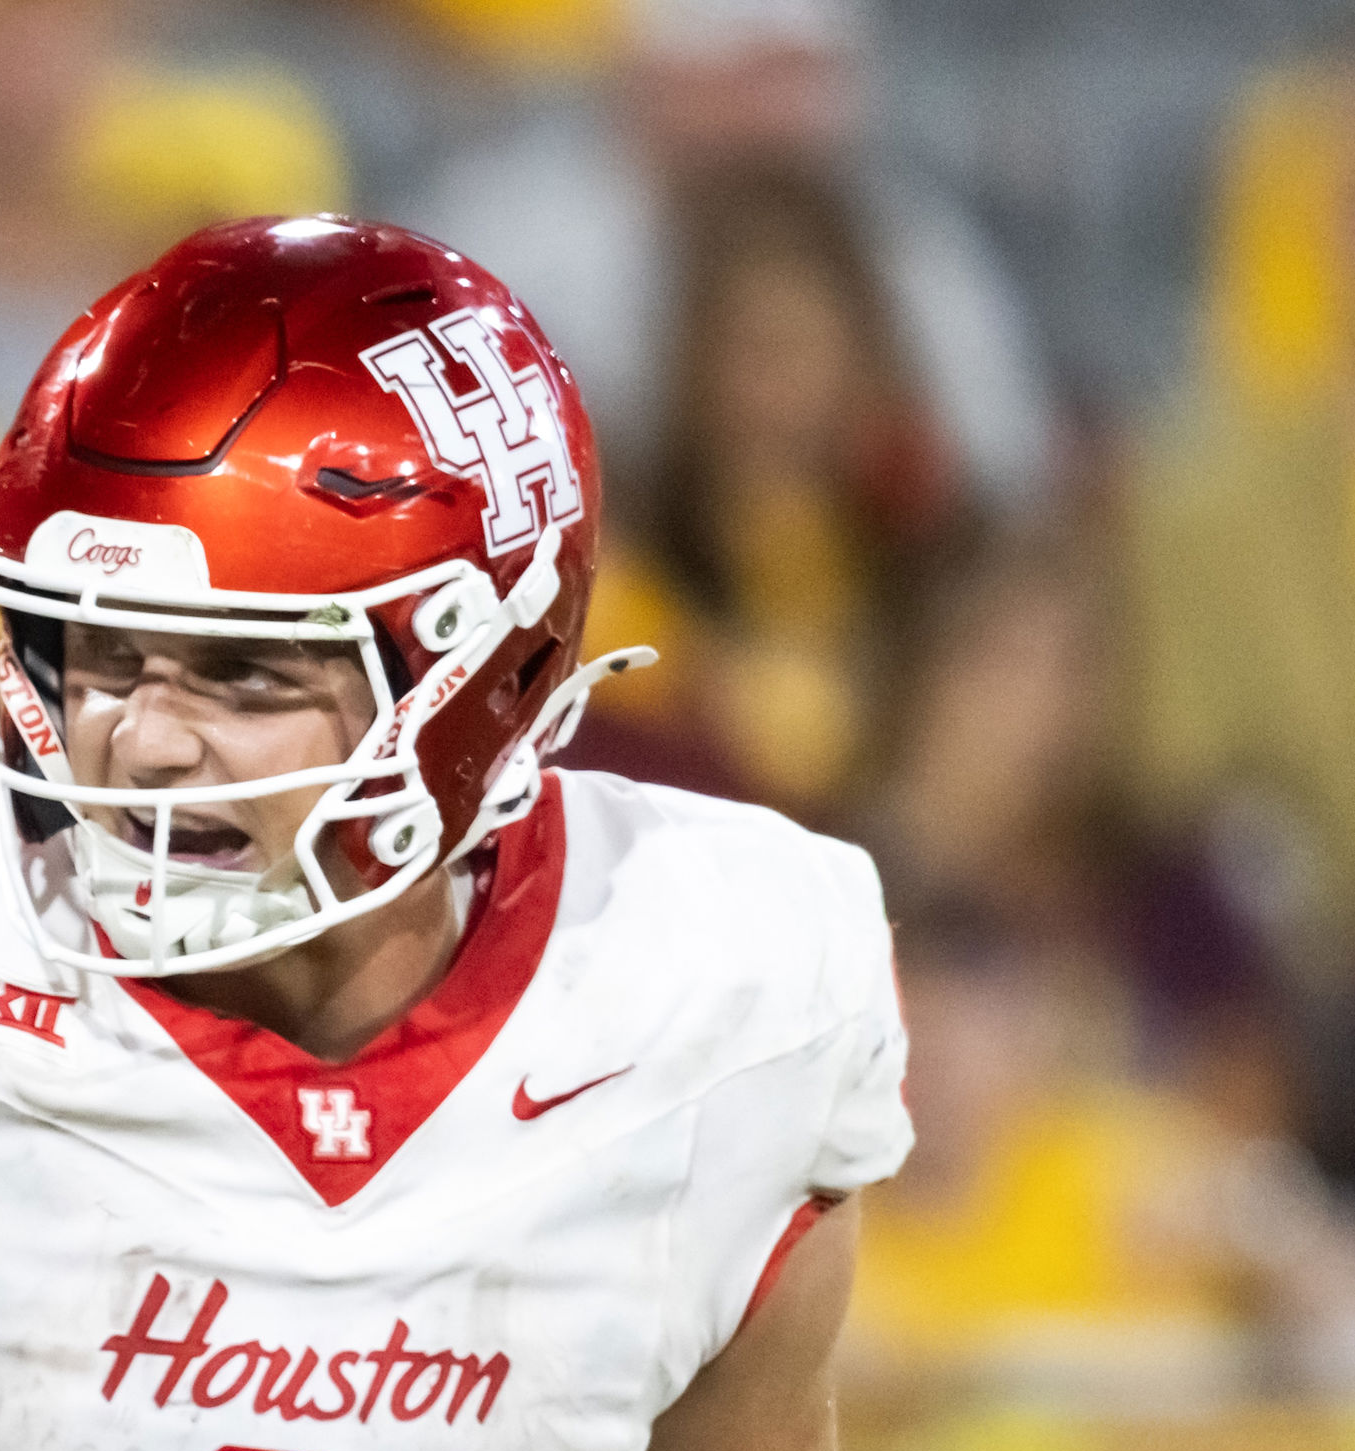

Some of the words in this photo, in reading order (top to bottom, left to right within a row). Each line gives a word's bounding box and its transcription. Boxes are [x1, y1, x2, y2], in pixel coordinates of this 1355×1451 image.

[358, 307, 583, 558] UH
[67, 527, 143, 574] Coogs
[298, 1089, 371, 1157] UH
[102, 1273, 511, 1425] Houston
